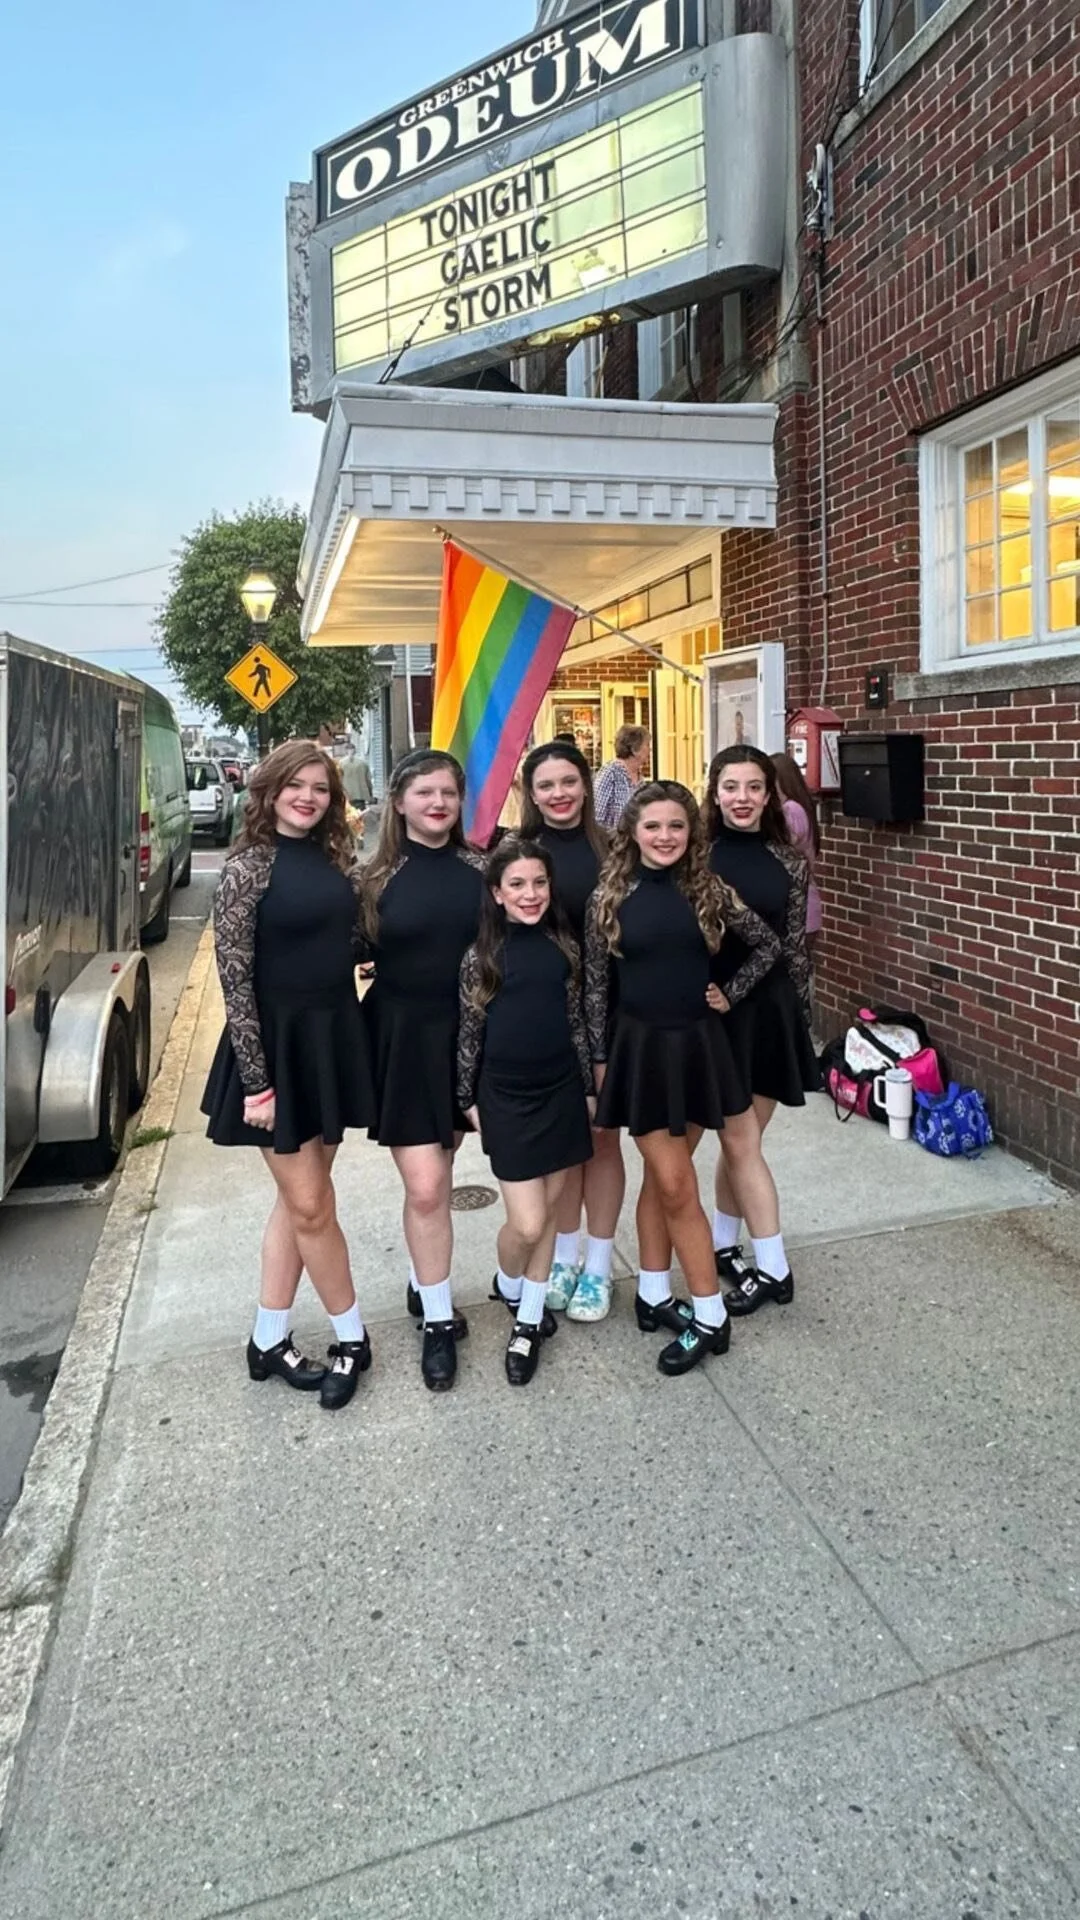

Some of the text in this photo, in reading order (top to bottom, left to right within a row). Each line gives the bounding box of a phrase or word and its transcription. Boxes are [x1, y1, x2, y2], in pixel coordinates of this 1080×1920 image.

[335, 0, 671, 200] ODEUM
[399, 29, 565, 128] GREENWICH
[420, 160, 556, 248] TONIGHT
[441, 215, 552, 285] GAELIC
[444, 264, 551, 331] STORM
